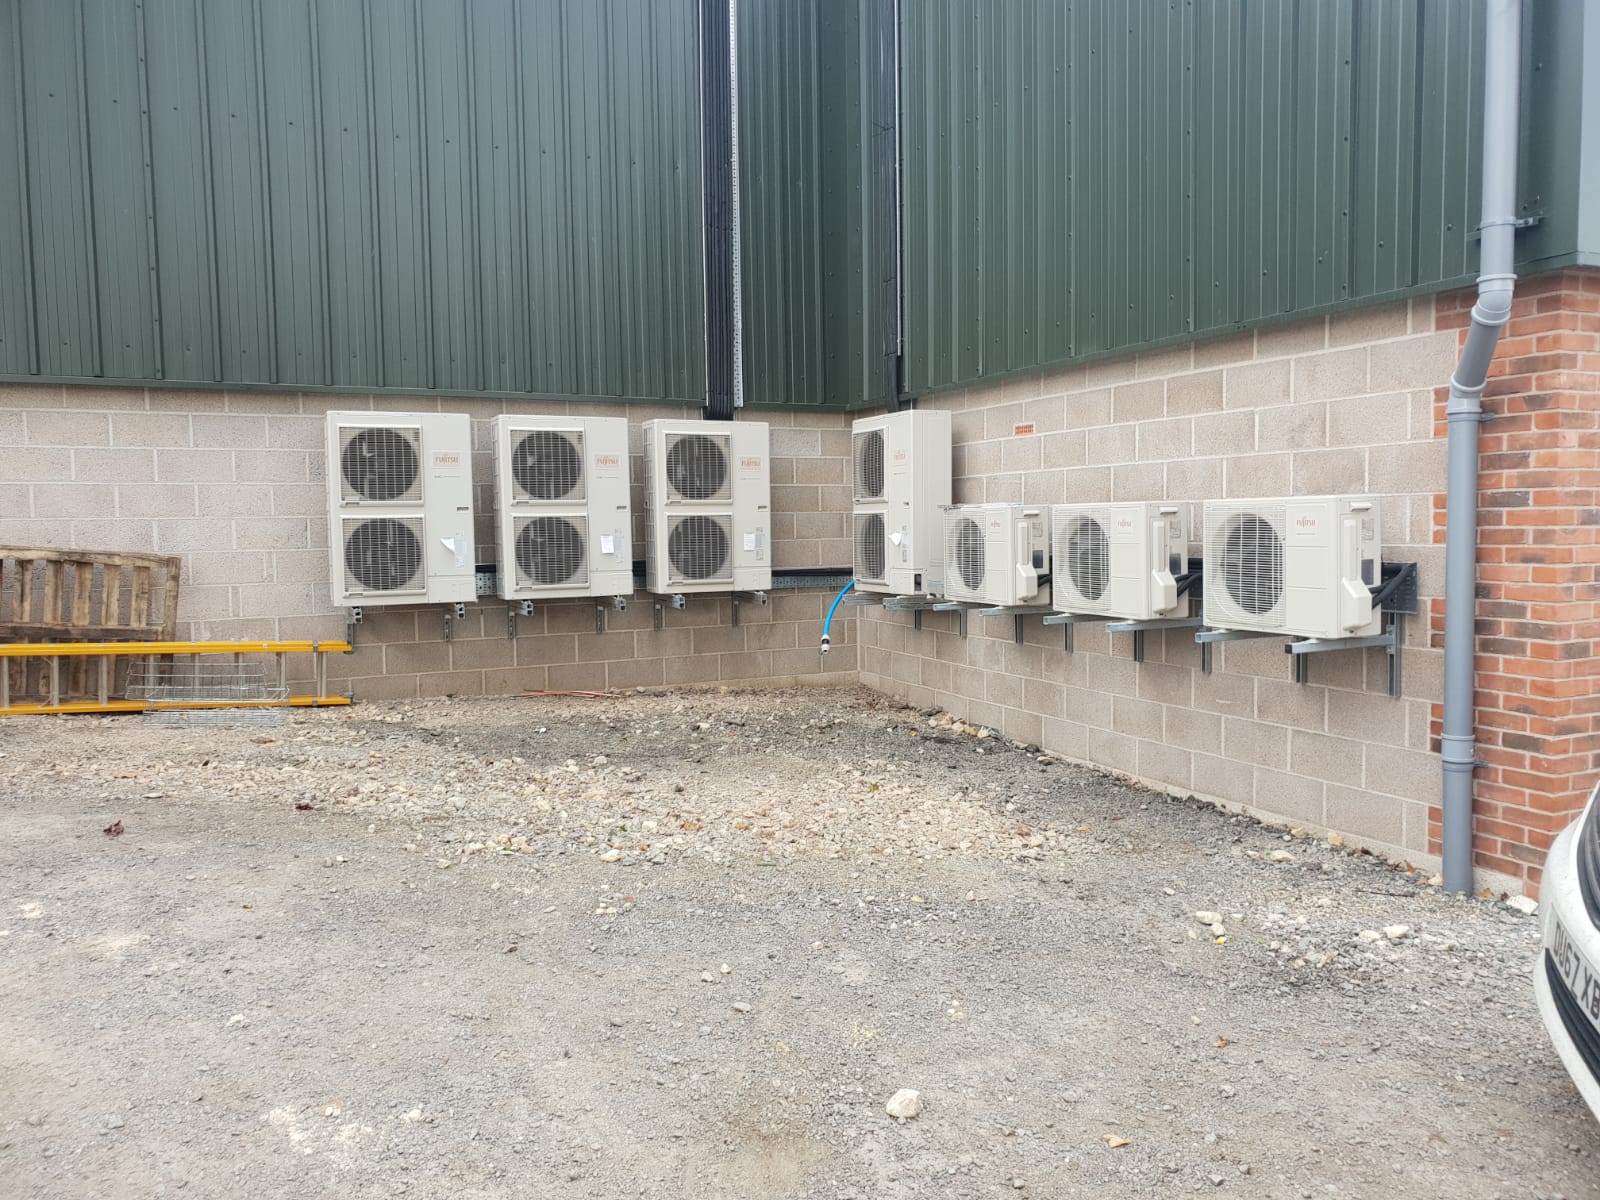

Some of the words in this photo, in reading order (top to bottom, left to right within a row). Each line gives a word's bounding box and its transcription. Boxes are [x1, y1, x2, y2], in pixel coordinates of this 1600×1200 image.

[435, 453, 460, 465] FUJITSU
[597, 456, 619, 466] FUJITSU
[1296, 516, 1316, 528] FUJITSU
[1553, 921, 1581, 990] DU67
